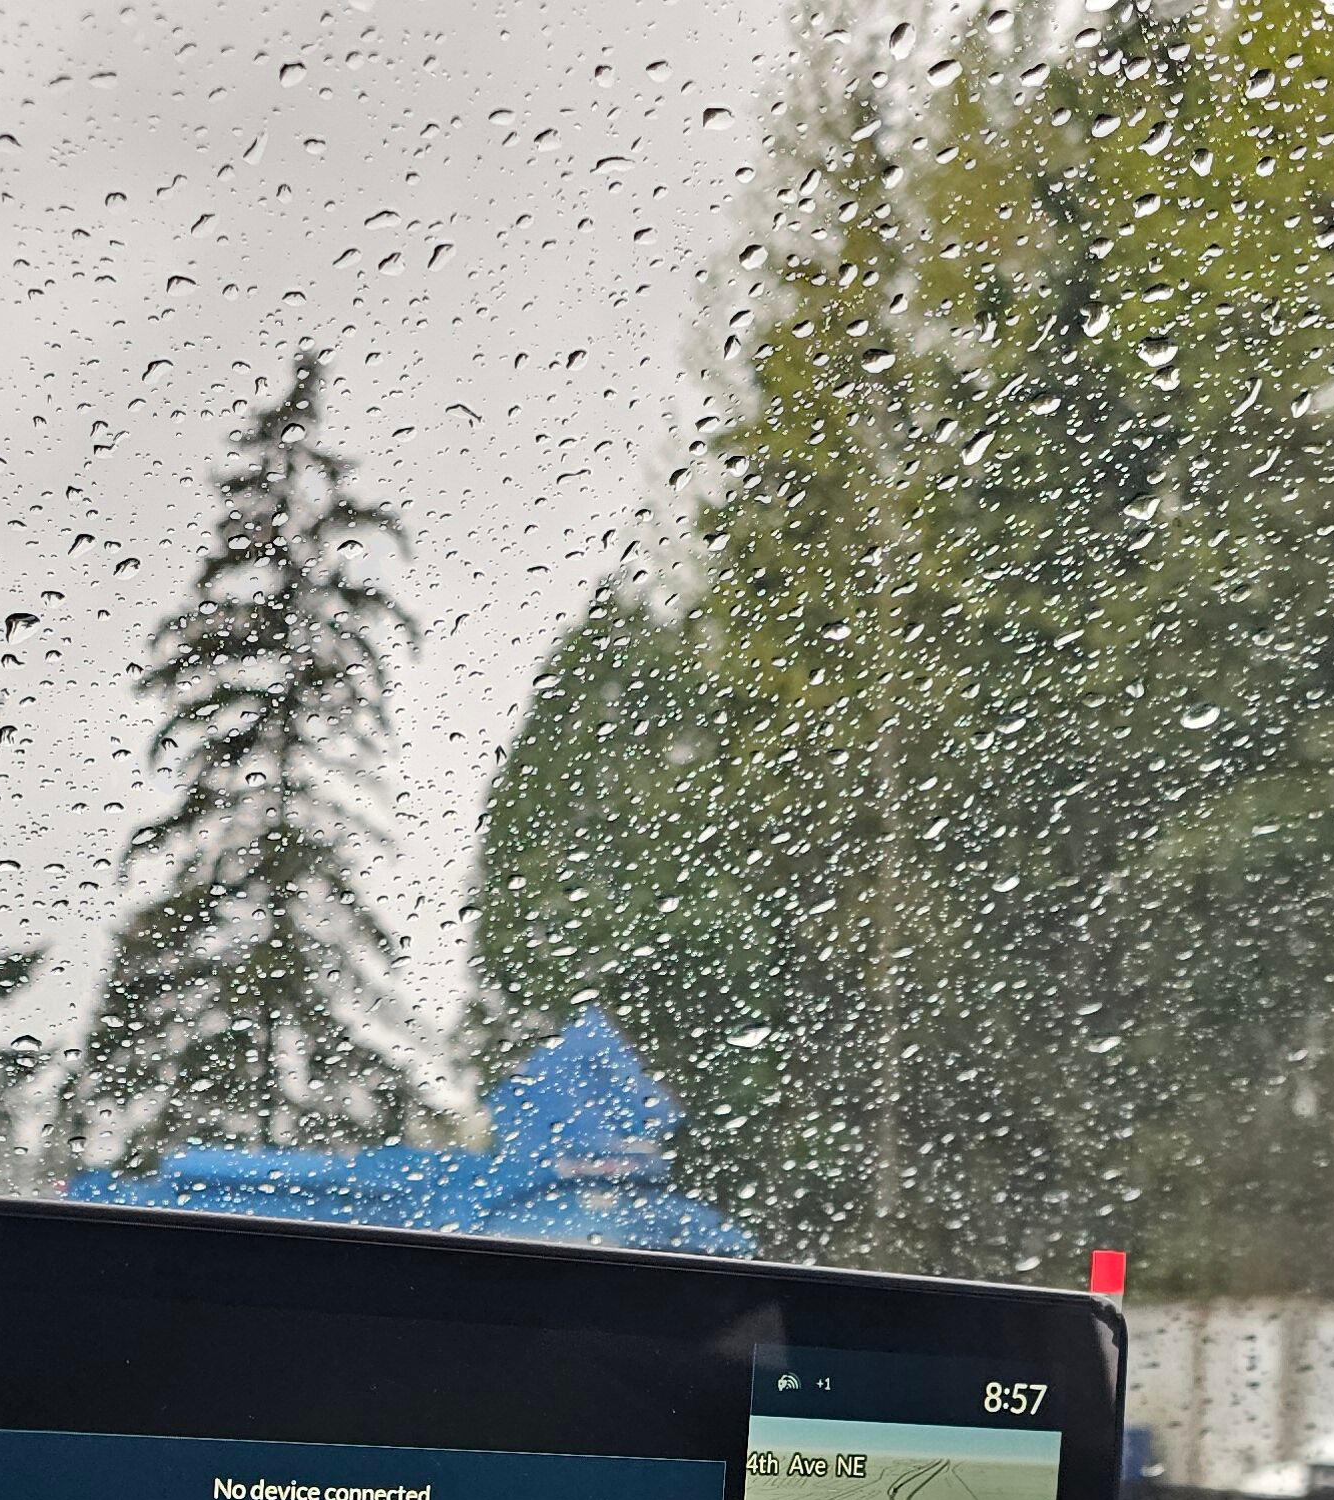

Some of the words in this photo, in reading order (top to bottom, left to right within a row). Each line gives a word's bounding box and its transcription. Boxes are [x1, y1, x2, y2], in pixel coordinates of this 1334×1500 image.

[816, 1377, 831, 1391] +1
[983, 1381, 1048, 1415] 8:57
[789, 1455, 826, 1475] Ave
[837, 1456, 865, 1476] NE
[214, 1478, 246, 1500] No
